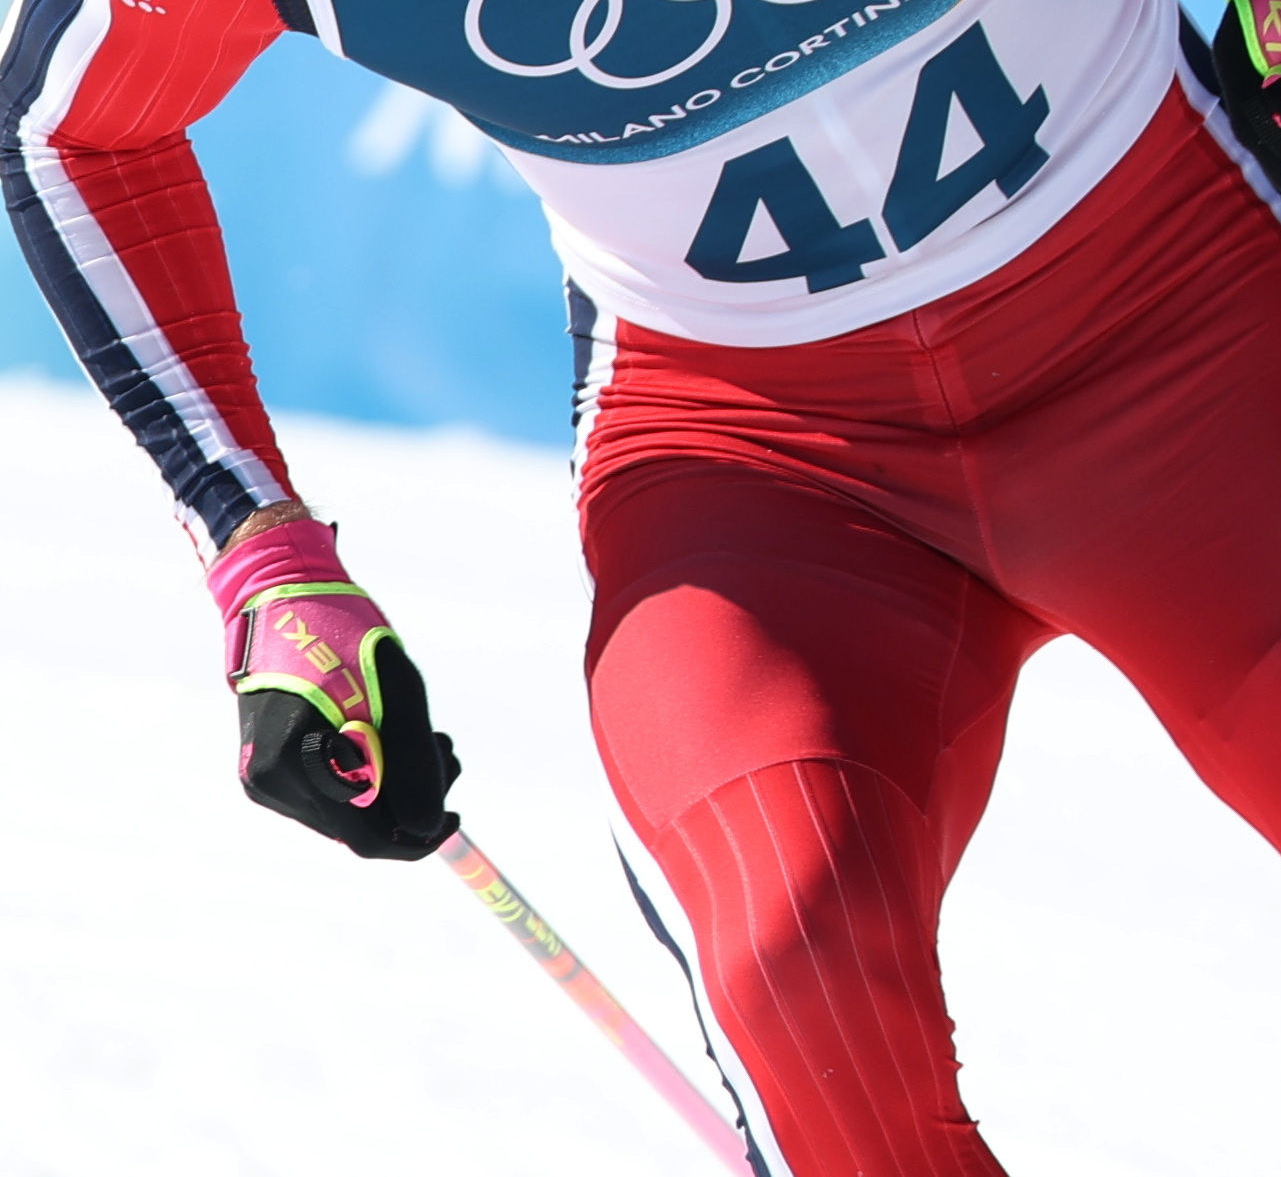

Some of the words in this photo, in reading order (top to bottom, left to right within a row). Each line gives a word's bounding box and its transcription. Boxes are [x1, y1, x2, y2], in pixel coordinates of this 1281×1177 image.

[535, 88, 721, 143] MILANO
[684, 20, 1051, 295] 44
[274, 610, 365, 710] LEKI
